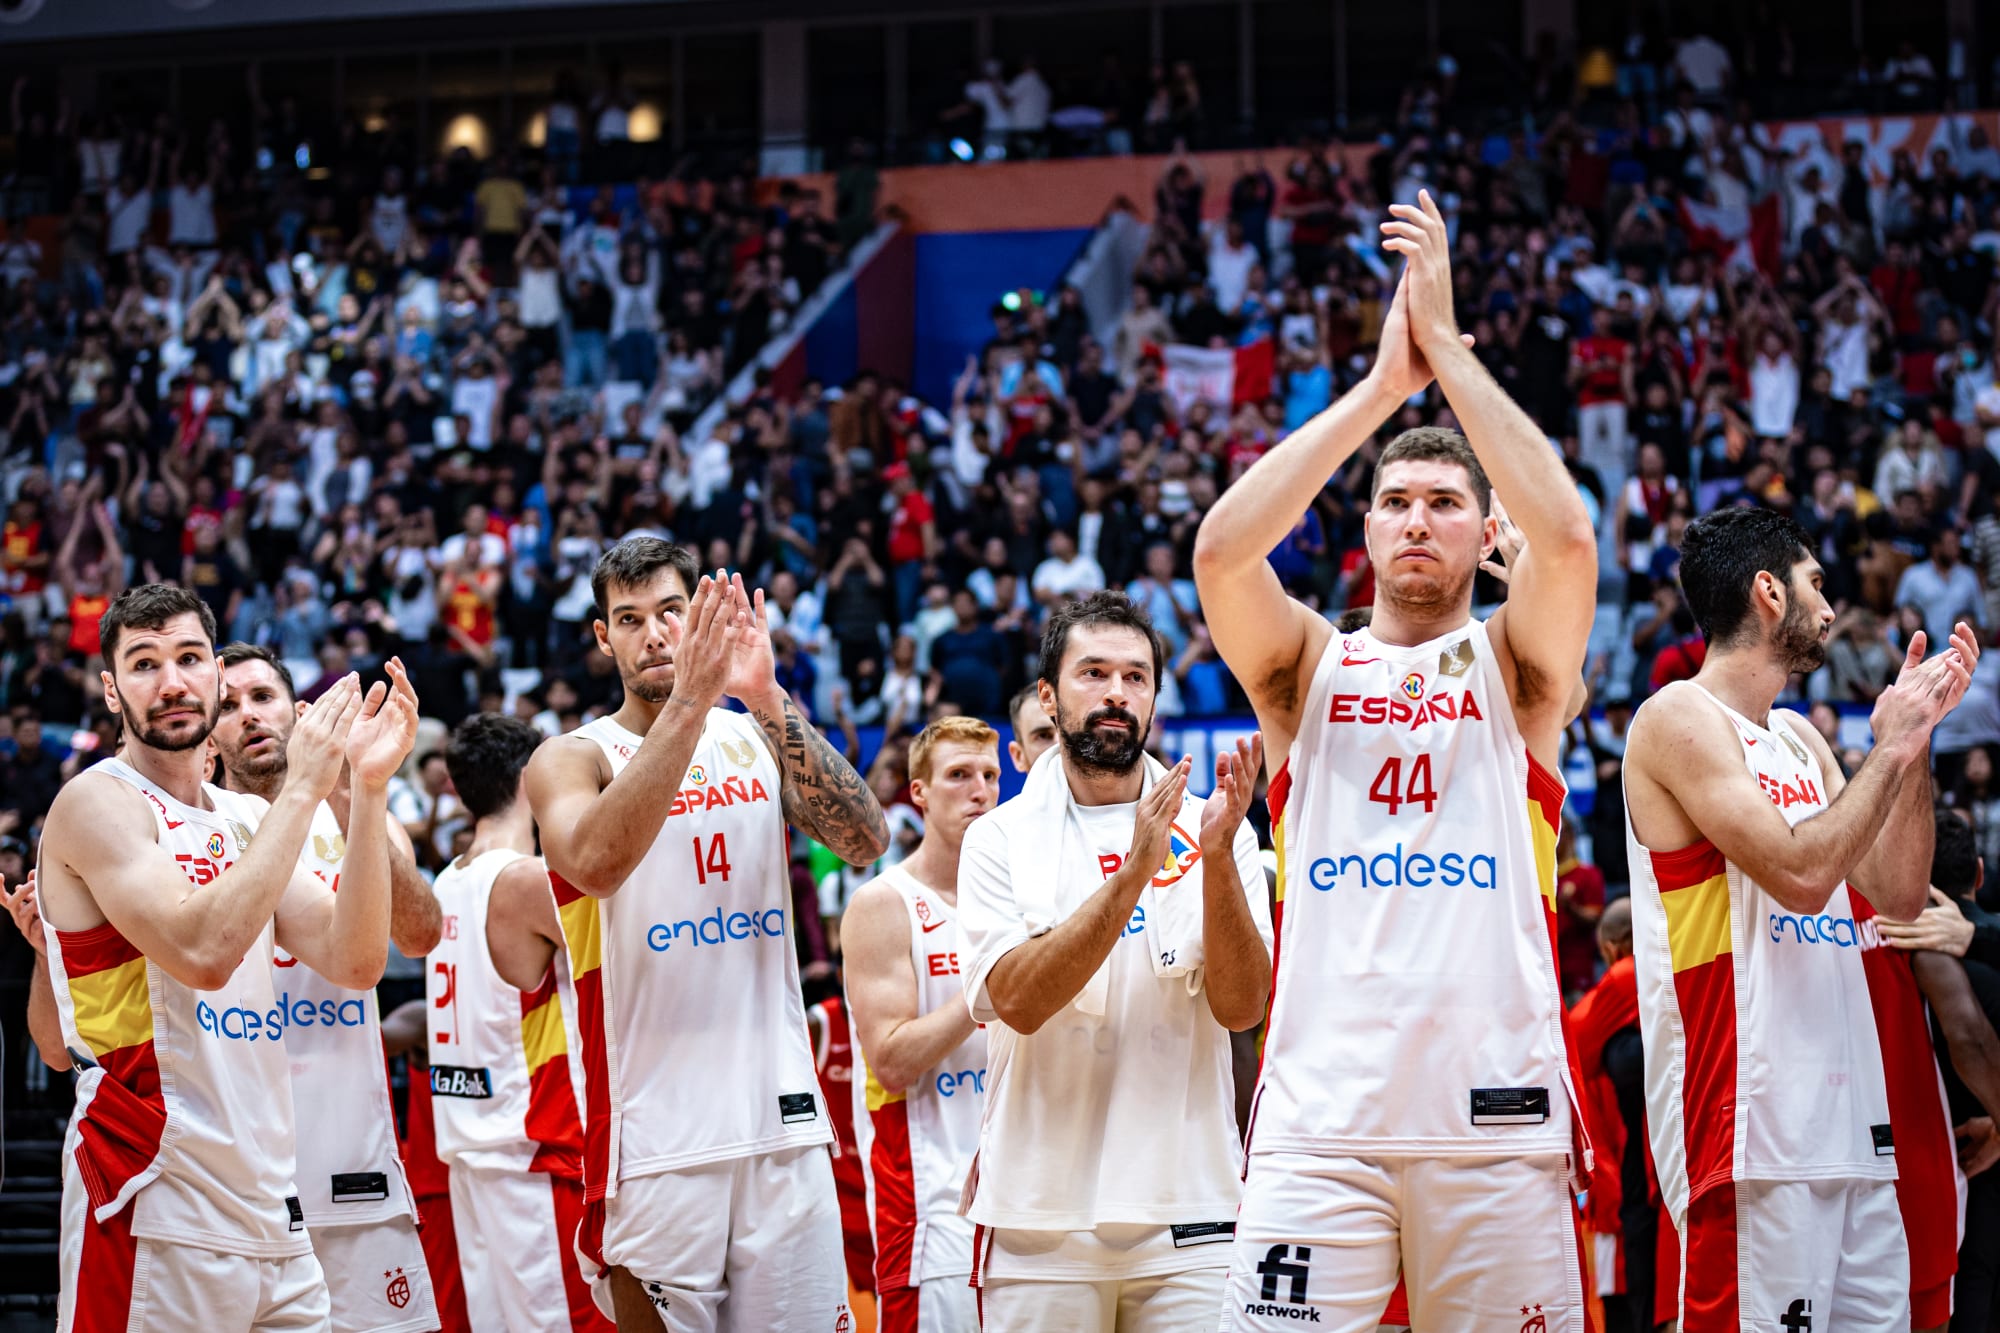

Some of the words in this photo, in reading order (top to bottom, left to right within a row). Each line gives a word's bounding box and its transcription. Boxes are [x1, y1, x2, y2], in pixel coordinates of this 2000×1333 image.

[1329, 690, 1484, 731] ESPAÑA
[667, 776, 769, 817] SPAÑA
[1369, 753, 1438, 816] 44
[693, 832, 731, 885] 14
[1309, 843, 1497, 891] endesa
[647, 906, 785, 952] endesa
[1257, 1244, 1311, 1305] fi
[1245, 1303, 1321, 1323] network
